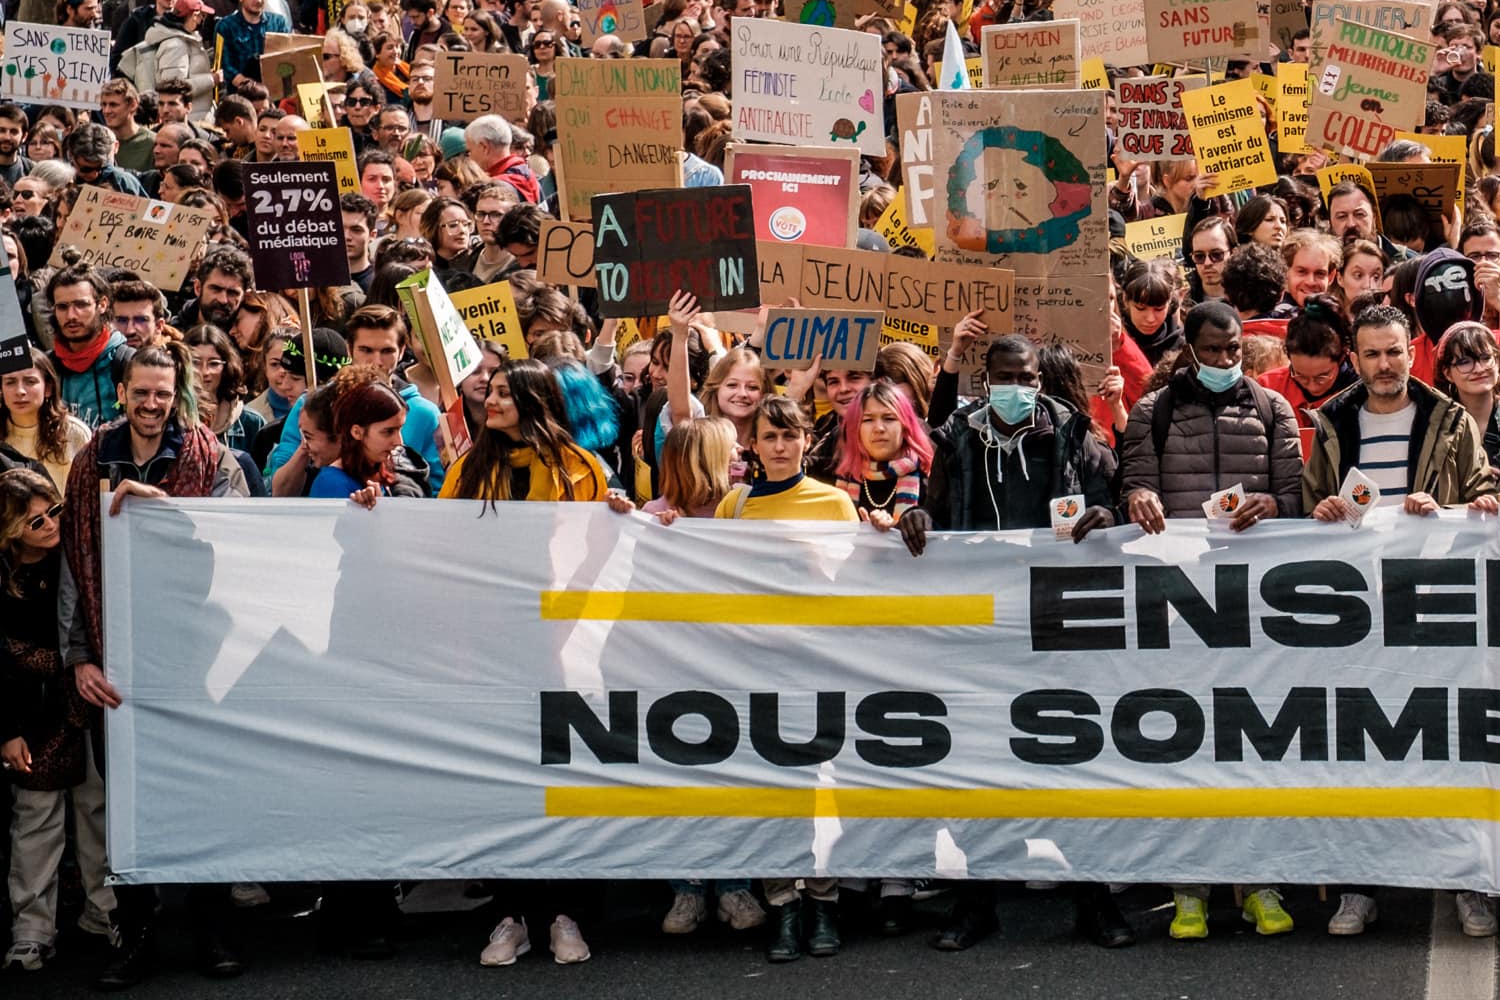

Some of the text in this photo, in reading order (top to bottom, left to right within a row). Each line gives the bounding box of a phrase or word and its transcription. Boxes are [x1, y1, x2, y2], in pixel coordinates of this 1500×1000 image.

[1159, 6, 1210, 28] SANS
[67, 32, 109, 52] TERRE
[994, 30, 1061, 50] DEMAIN
[1182, 29, 1234, 47] FUTUR
[778, 31, 878, 78] une République
[447, 55, 509, 79] Terrien
[1120, 81, 1168, 104] DANS
[1333, 74, 1400, 102] Jeunes
[443, 92, 524, 114] T'ES RIEN
[1211, 94, 1227, 106] Le
[605, 107, 673, 130] CHANGE
[738, 107, 813, 138] ANTIRACISTE
[942, 116, 1001, 127] biodiversité
[1192, 105, 1254, 128] féminisme
[1123, 132, 1164, 154] QUE
[1218, 126, 1237, 139] est
[1200, 136, 1262, 160] l'avenir du
[251, 171, 330, 184] Seulement
[741, 170, 841, 185] PROCHAINEMENT
[782, 184, 798, 192] ICI
[251, 189, 332, 216] 2,7%
[257, 219, 337, 235] du débat
[596, 195, 748, 247] A FUTURE
[776, 218, 798, 232] VOTE
[258, 234, 338, 251] médiatique
[596, 257, 744, 301] TO IN
[805, 258, 936, 308] JEUNESSE
[1037, 298, 1084, 309] perdue
[765, 315, 875, 361] CLIMAT
[540, 689, 952, 768] NOUS
